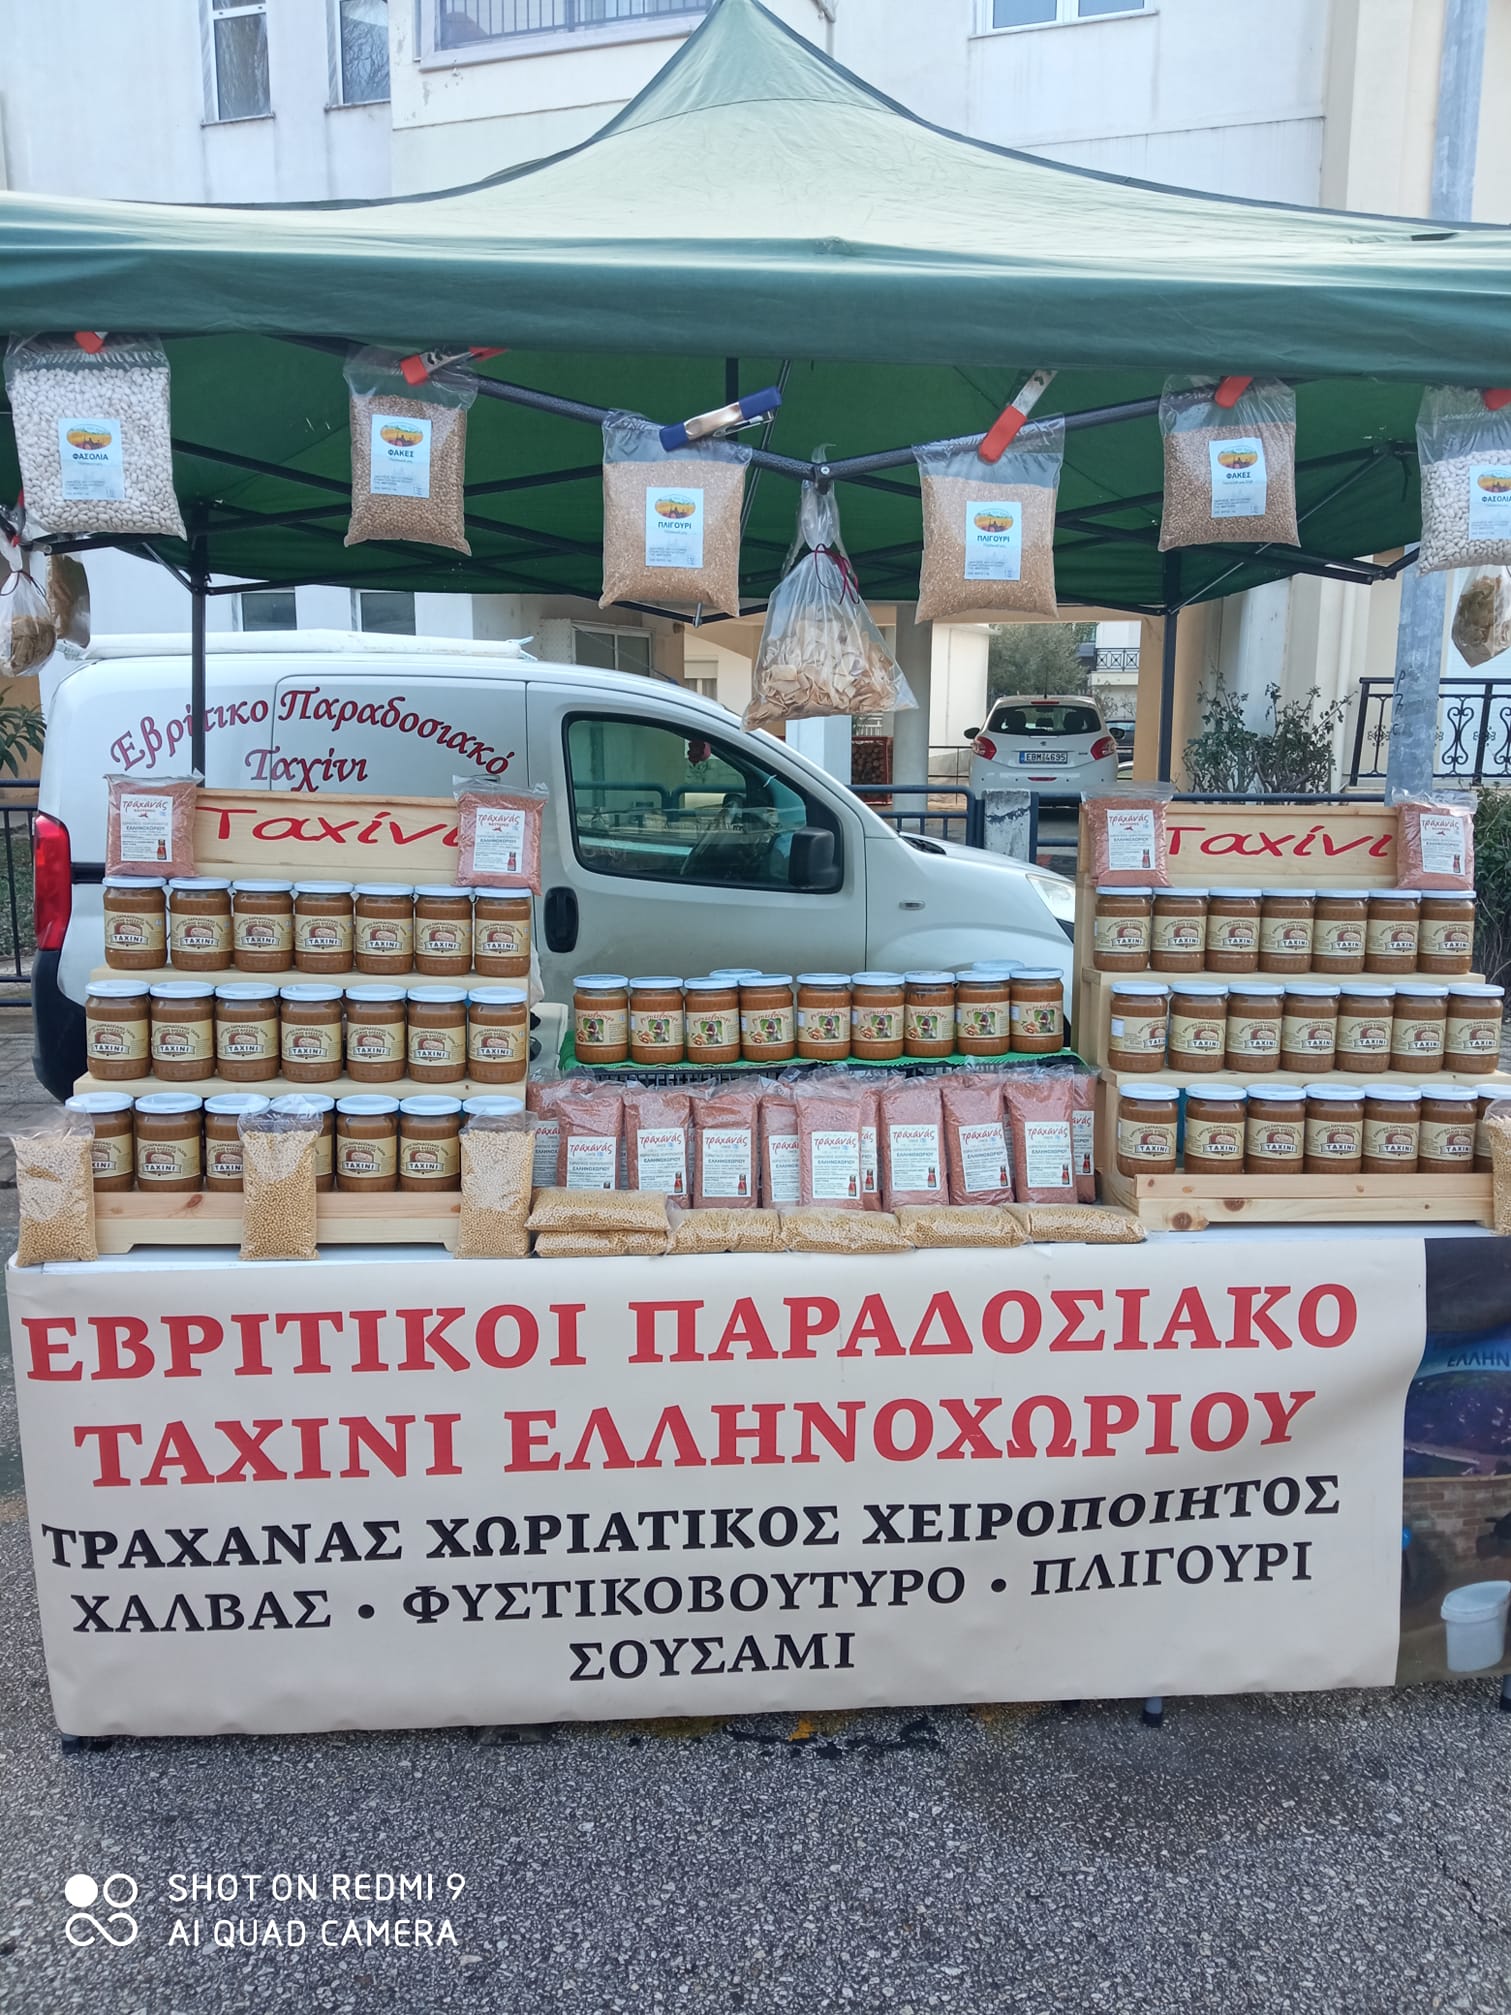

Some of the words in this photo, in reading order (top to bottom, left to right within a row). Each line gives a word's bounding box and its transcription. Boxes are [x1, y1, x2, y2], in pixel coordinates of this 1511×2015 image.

[72, 452, 109, 461] ΦΑΣΟΛΙΑ
[387, 449, 414, 458] ΦΑΚΕΣ
[1226, 471, 1252, 480] ΦΑΚΕΣ
[657, 521, 692, 530] ΠΛΙΓΟΥΡΙ
[977, 534, 1011, 543] ΠΛΙΓΟΥΡΙ
[278, 686, 515, 775] Παραδοσιακό
[244, 746, 368, 792] Ταχίνι
[122, 799, 169, 813] τραχανάς
[196, 806, 460, 846] Ταχίνι
[1165, 825, 1393, 858] Ταχίνι
[639, 1132, 682, 1147] τραχανάς
[705, 1133, 749, 1148] τραχανάς
[893, 1128, 936, 1142] τραχανάς
[962, 1129, 1002, 1146] τραχανάς
[1028, 1127, 1069, 1141] τραχανάς
[569, 1142, 613, 1156] τραχανάς
[814, 1135, 857, 1150] τραχανάς
[21, 1303, 588, 1382] ΕΒΡΙΤΙΚΟΙ
[628, 1283, 1358, 1363] ΠΑΡΑΔΟΣΙΑΚΟ
[74, 1413, 462, 1487] ΤΑΧΙΝΙ
[503, 1391, 1316, 1474] ΕΛΛΗΝΟΧΩΡΙΟΥ
[41, 1520, 403, 1570] ΤΡΑΧΑΝΑΣ
[426, 1505, 840, 1559] ΧΩΡΙΑΤΙΚΟΣ
[862, 1475, 1340, 1545] ΧΕΙΡΟΠΟΙΗΤΟΣ
[72, 1590, 331, 1633] ΧΑΛΒΑΣ
[402, 1567, 966, 1626] ΦΥΣΤΙΚΟΒΟΥΤΥΡΟ
[1030, 1541, 1313, 1596] ΠΛΙΓΟΥΡΙ
[569, 1632, 855, 1682] ΣΟΥΣΑΜΙ
